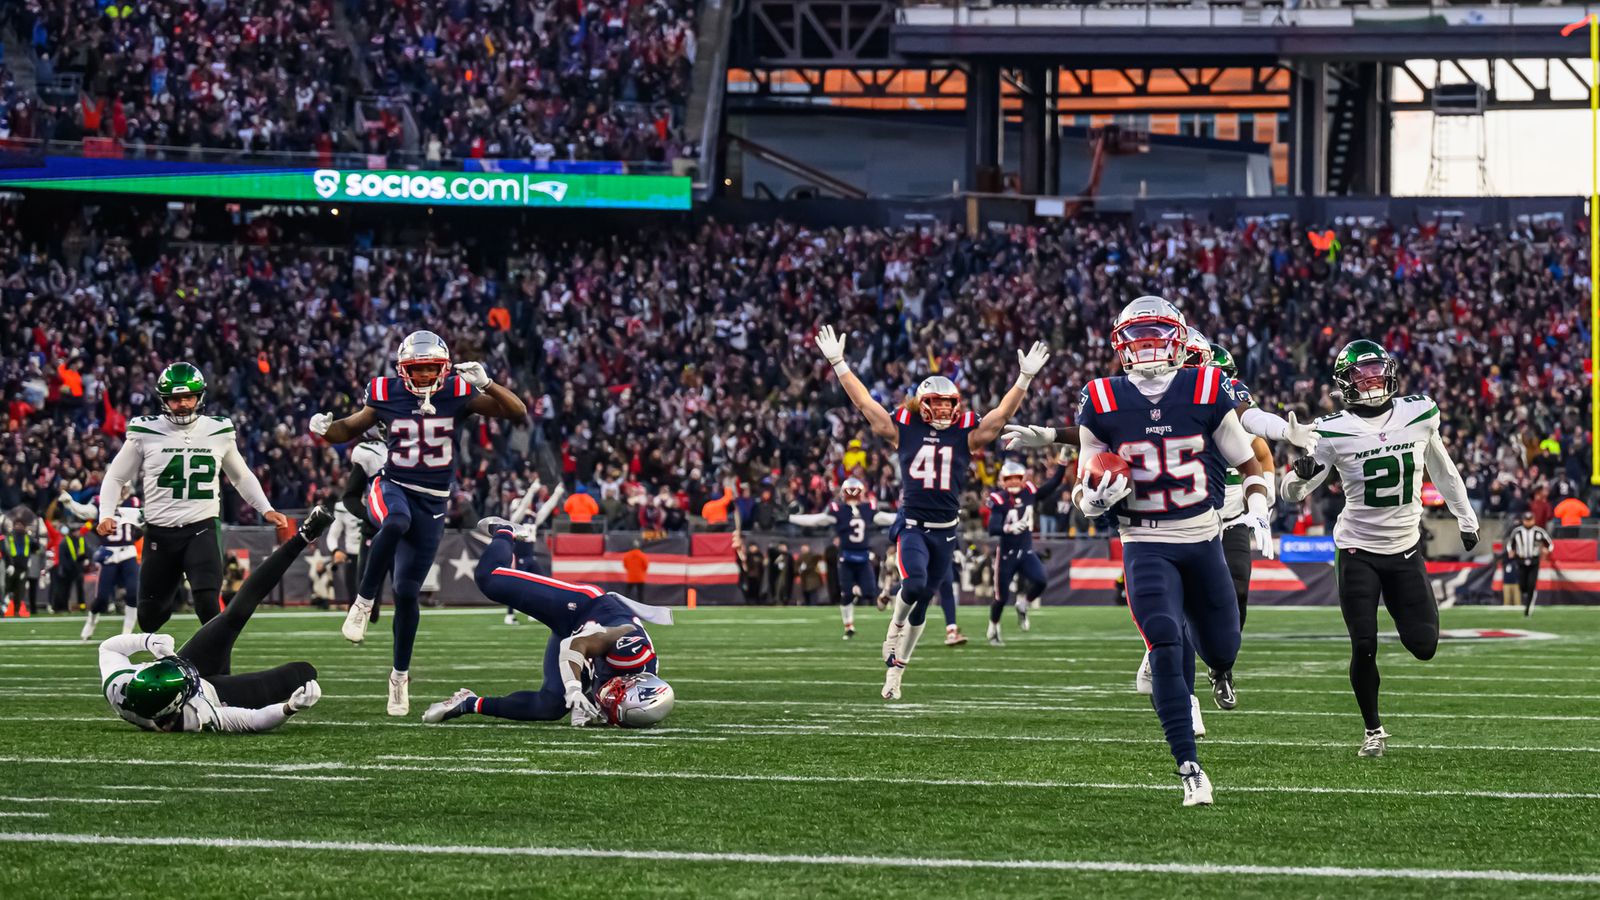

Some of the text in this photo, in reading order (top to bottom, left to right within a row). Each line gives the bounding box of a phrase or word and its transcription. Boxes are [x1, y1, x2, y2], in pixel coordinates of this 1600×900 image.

[390, 417, 454, 468] 35
[1354, 441, 1416, 460] NEW YORK
[157, 454, 217, 500] 42
[908, 444, 953, 491] 41
[1117, 433, 1209, 513] 25
[1362, 451, 1416, 508] 21
[848, 518, 866, 543] 3
